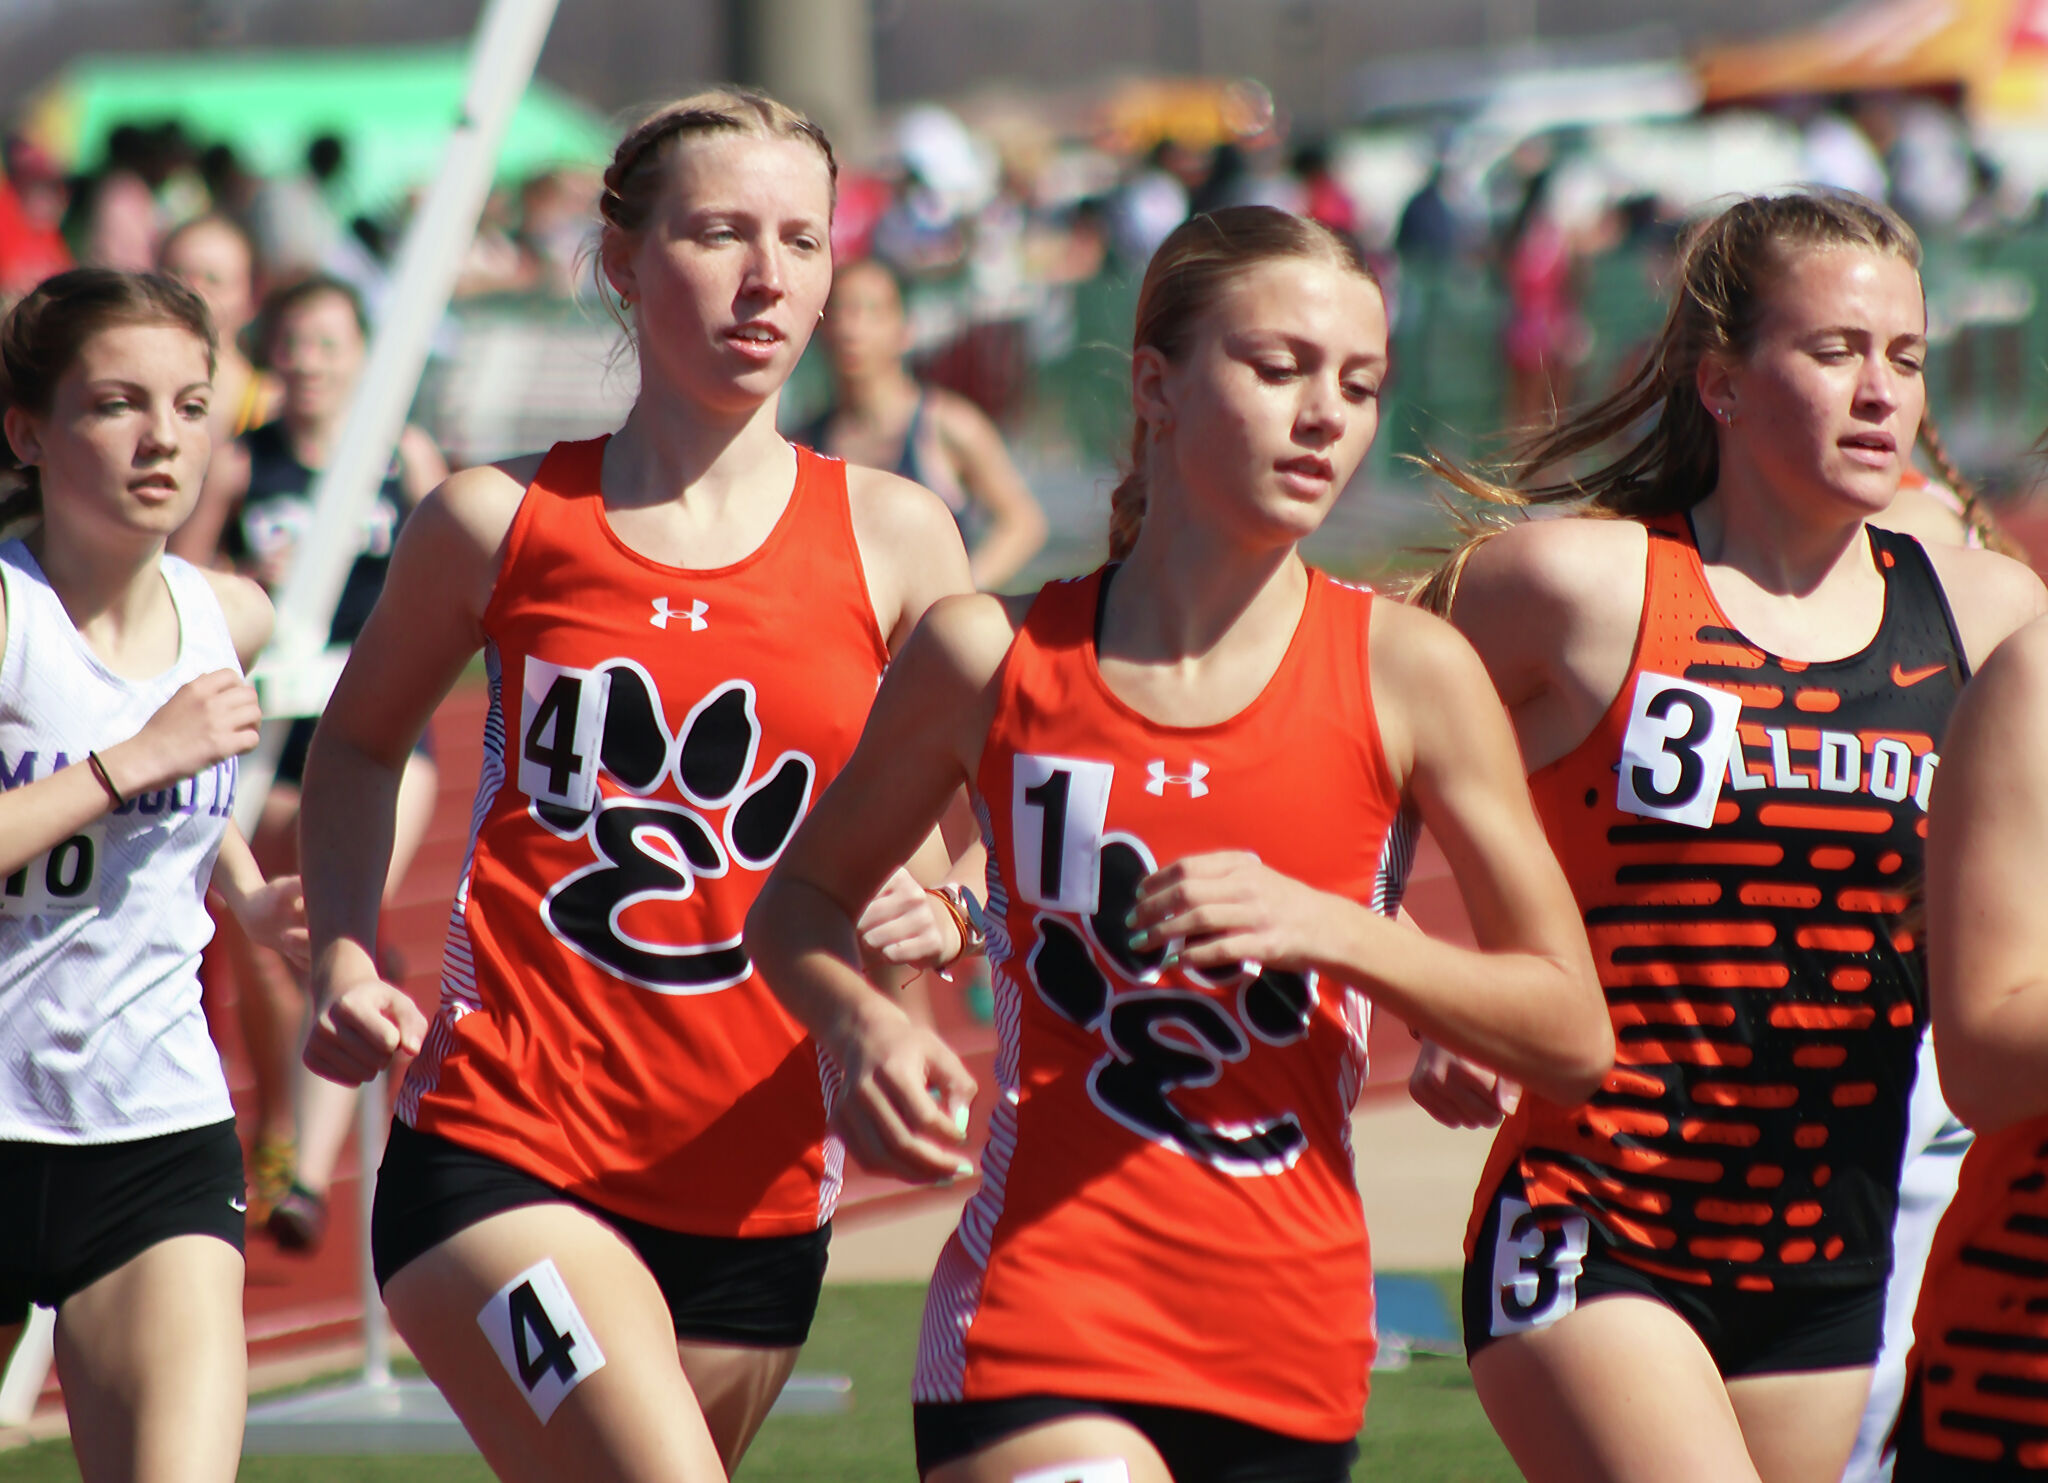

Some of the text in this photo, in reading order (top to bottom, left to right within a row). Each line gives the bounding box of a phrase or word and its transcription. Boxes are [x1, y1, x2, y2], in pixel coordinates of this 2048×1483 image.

[525, 675, 583, 797] 4
[1632, 688, 1713, 809] 3
[1727, 727, 1941, 812] LLDO
[1025, 769, 1072, 901] 1
[1501, 1211, 1569, 1323] 3
[509, 1280, 578, 1393] 4
